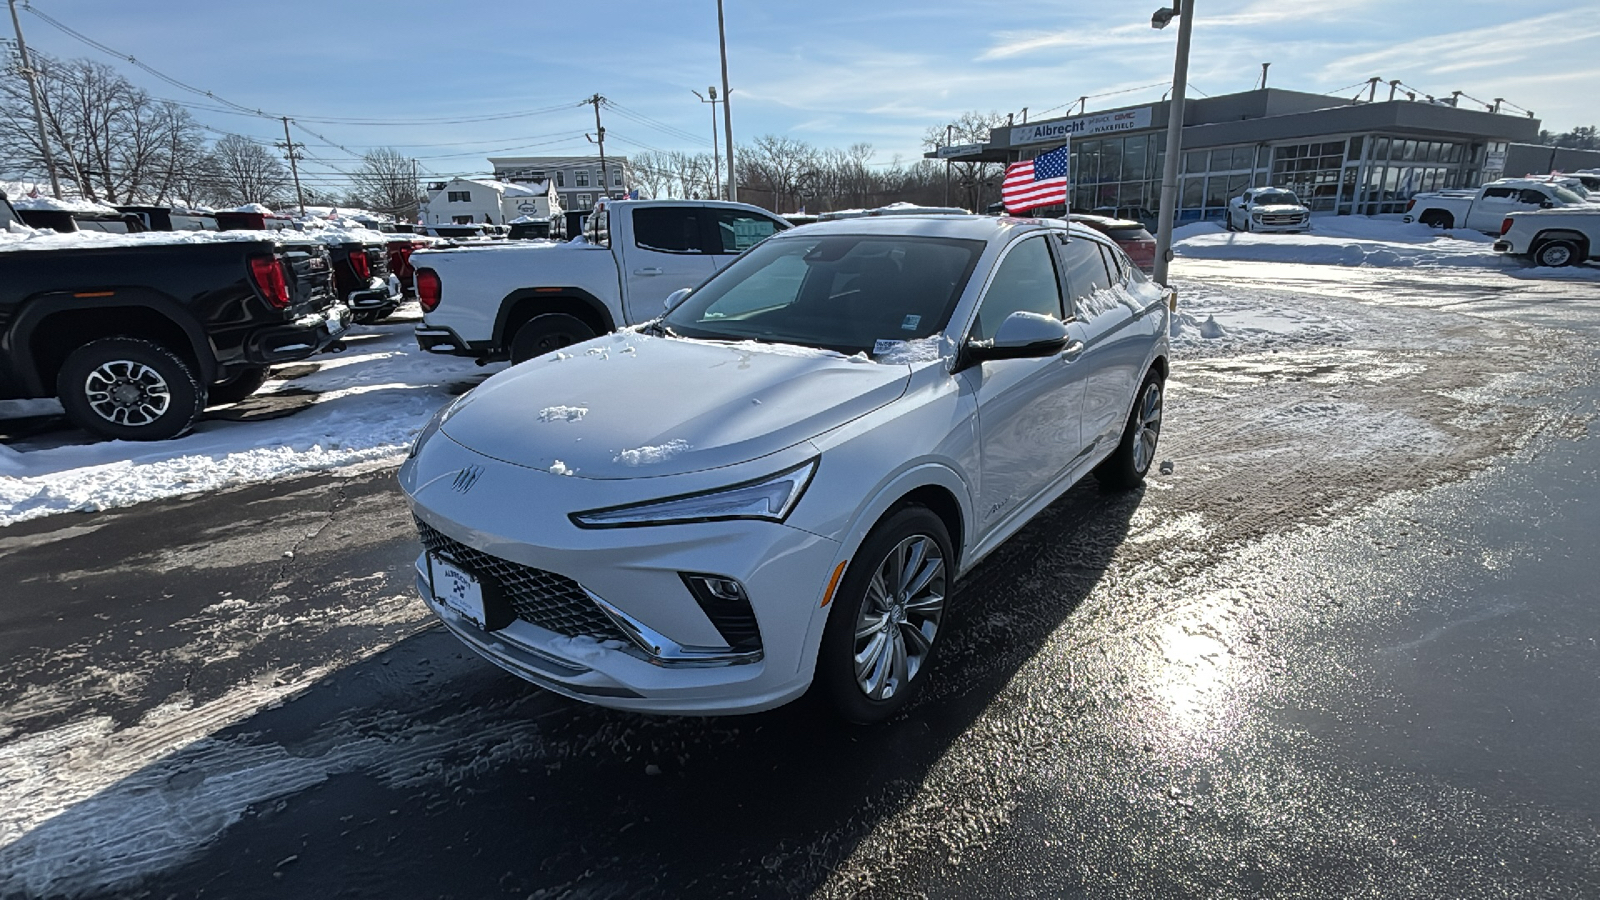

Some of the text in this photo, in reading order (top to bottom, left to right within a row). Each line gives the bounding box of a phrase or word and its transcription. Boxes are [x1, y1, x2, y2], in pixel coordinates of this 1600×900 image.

[1114, 111, 1136, 121] GMC
[1034, 120, 1085, 138] Albrecht
[1095, 121, 1135, 133] WAKEFIELD
